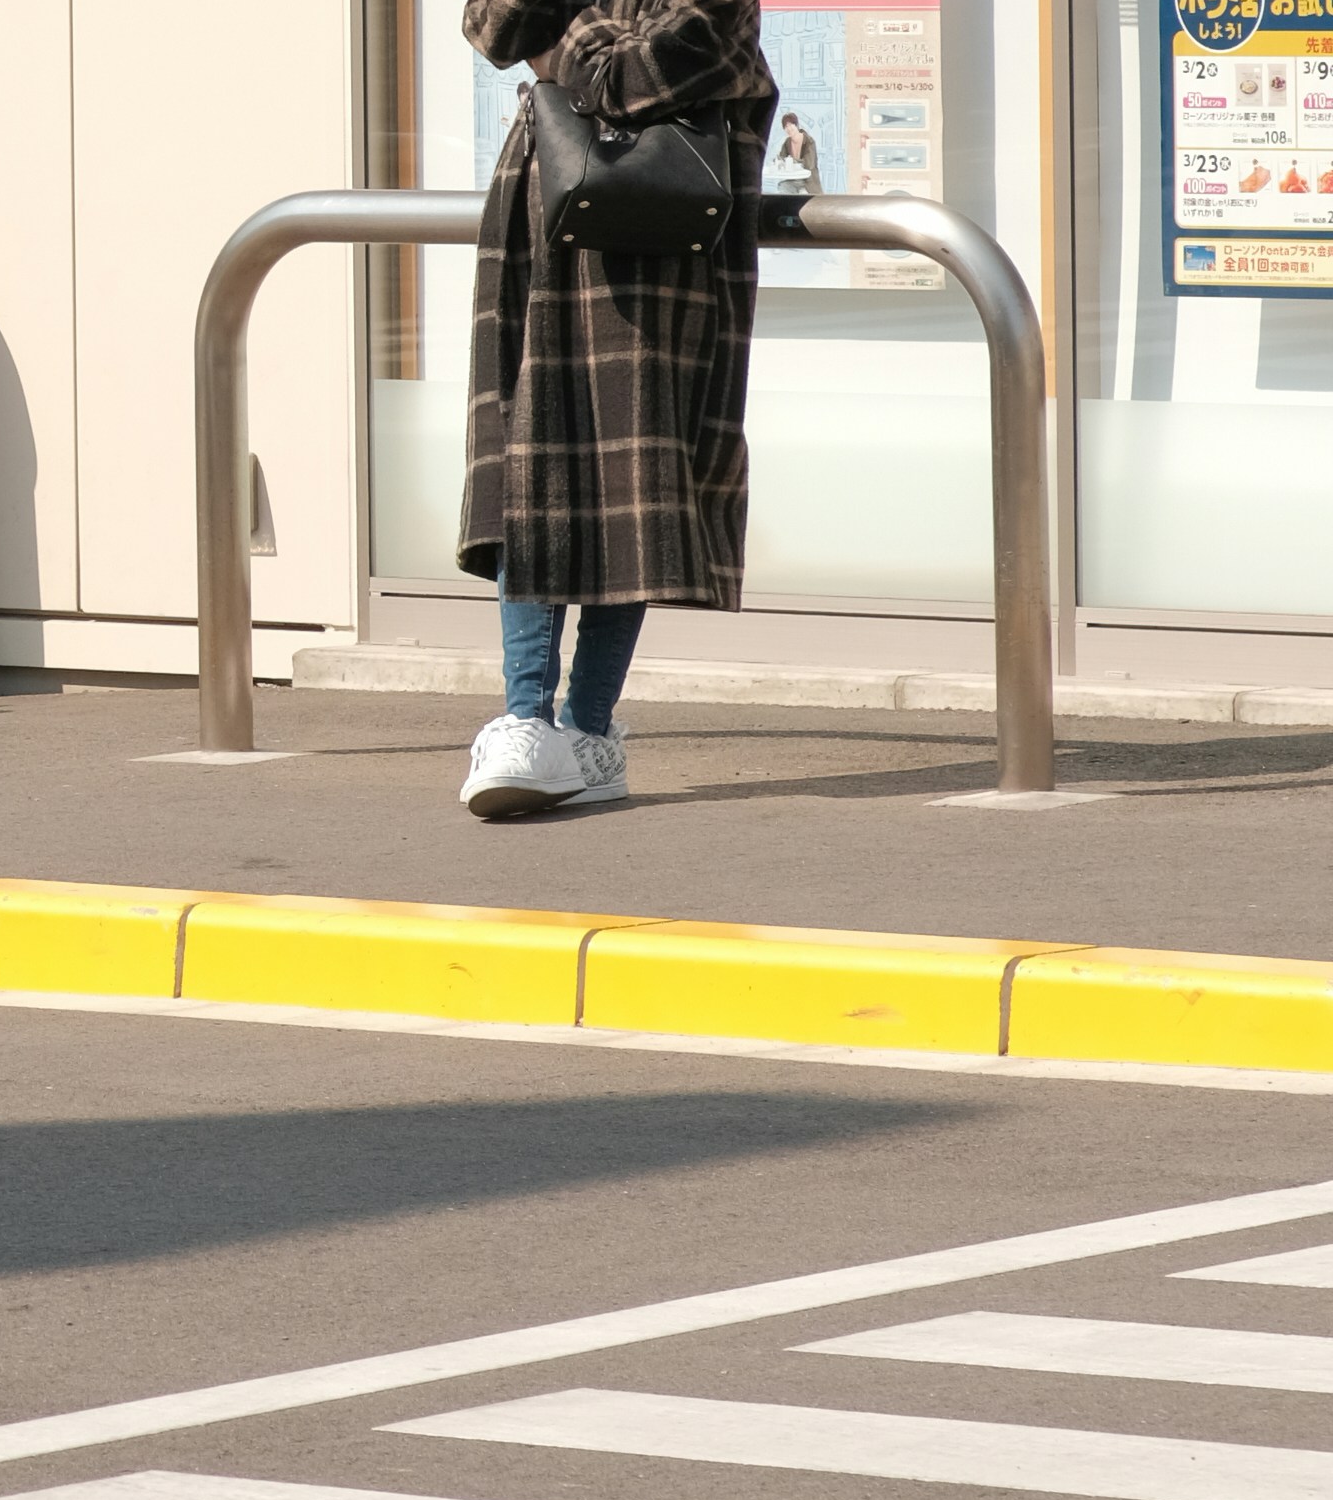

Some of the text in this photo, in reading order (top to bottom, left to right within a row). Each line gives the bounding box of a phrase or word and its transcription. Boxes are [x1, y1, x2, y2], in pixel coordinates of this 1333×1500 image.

[1199, 22, 1242, 40] しよう!
[1183, 209, 1224, 218] いずれか1個
[1223, 258, 1316, 274] 全員1回交換可能!
